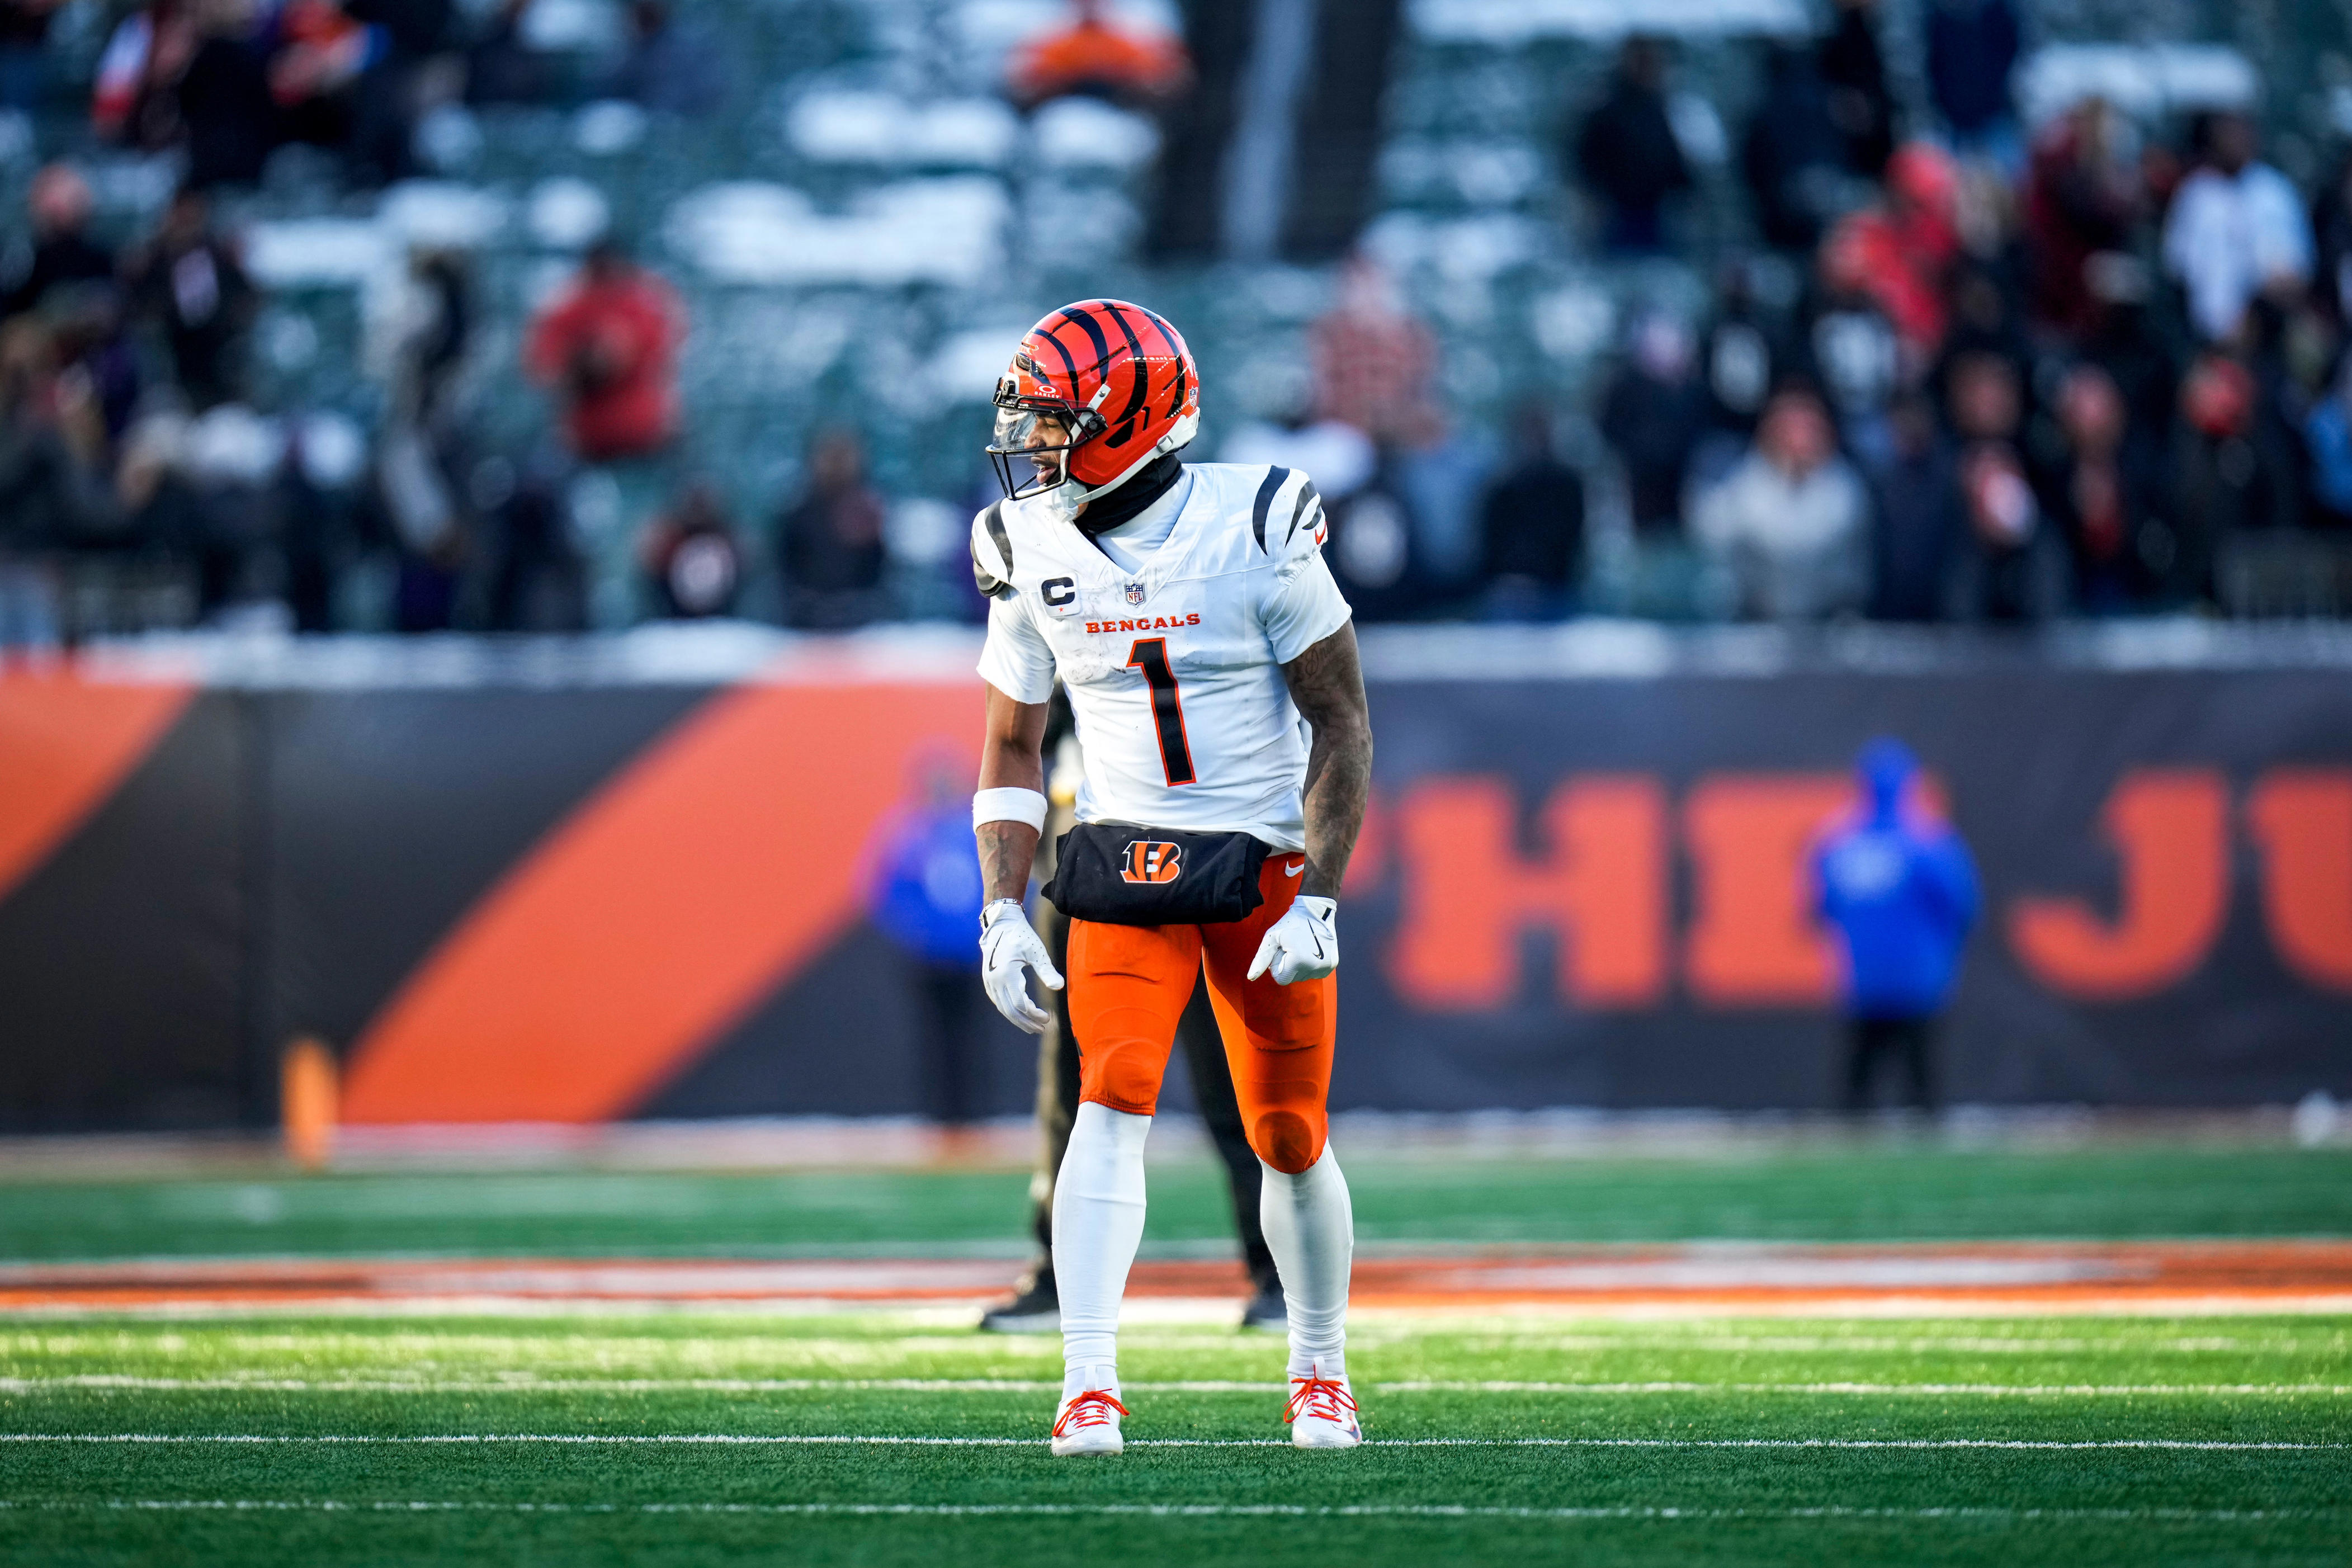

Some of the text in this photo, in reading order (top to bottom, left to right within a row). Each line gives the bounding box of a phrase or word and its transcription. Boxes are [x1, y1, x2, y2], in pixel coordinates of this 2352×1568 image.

[1041, 576, 1075, 606] C
[1128, 592, 1142, 602] NFL
[1085, 613, 1201, 633] BENGALS
[1126, 637, 1197, 787] 1
